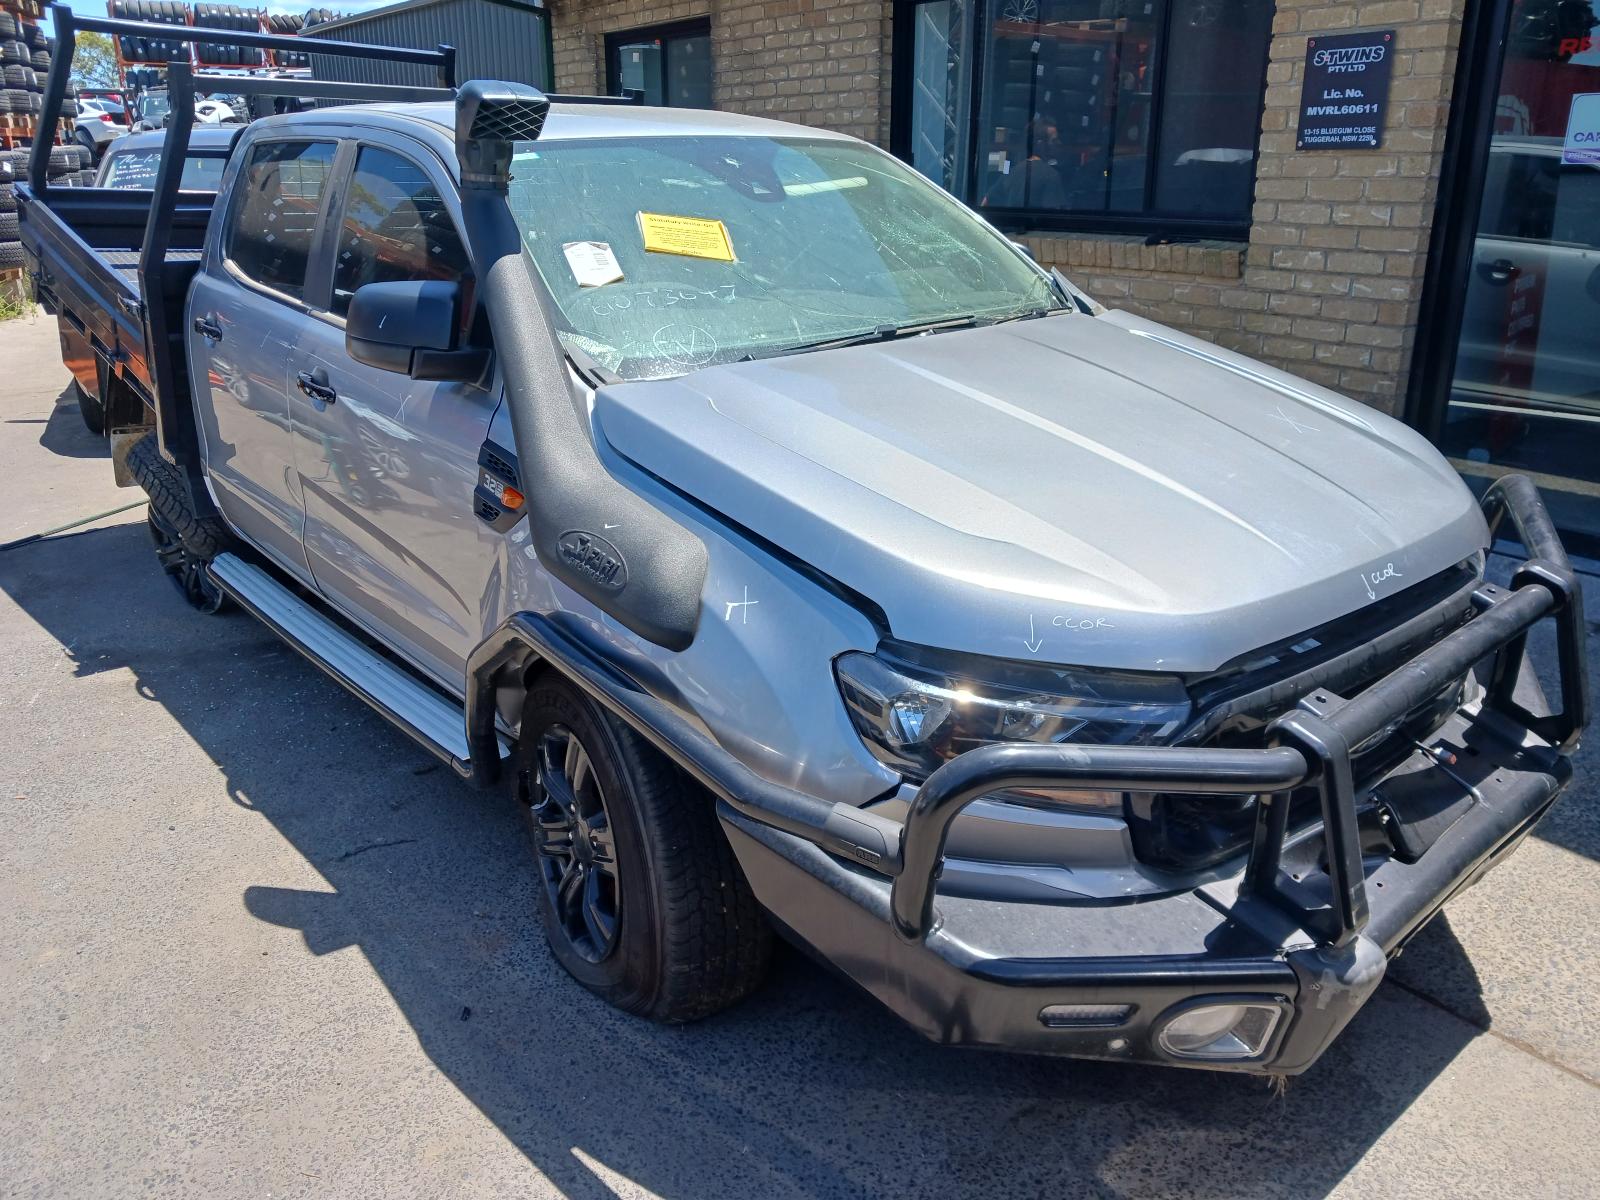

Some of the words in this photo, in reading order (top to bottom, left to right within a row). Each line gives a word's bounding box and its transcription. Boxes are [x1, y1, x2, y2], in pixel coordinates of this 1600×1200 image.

[1348, 64, 1366, 72] LTD
[1323, 89, 1343, 99] Lic.
[1345, 88, 1364, 98] No.
[1306, 103, 1378, 116] MVRL60611
[1353, 126, 1376, 134] CLOSE
